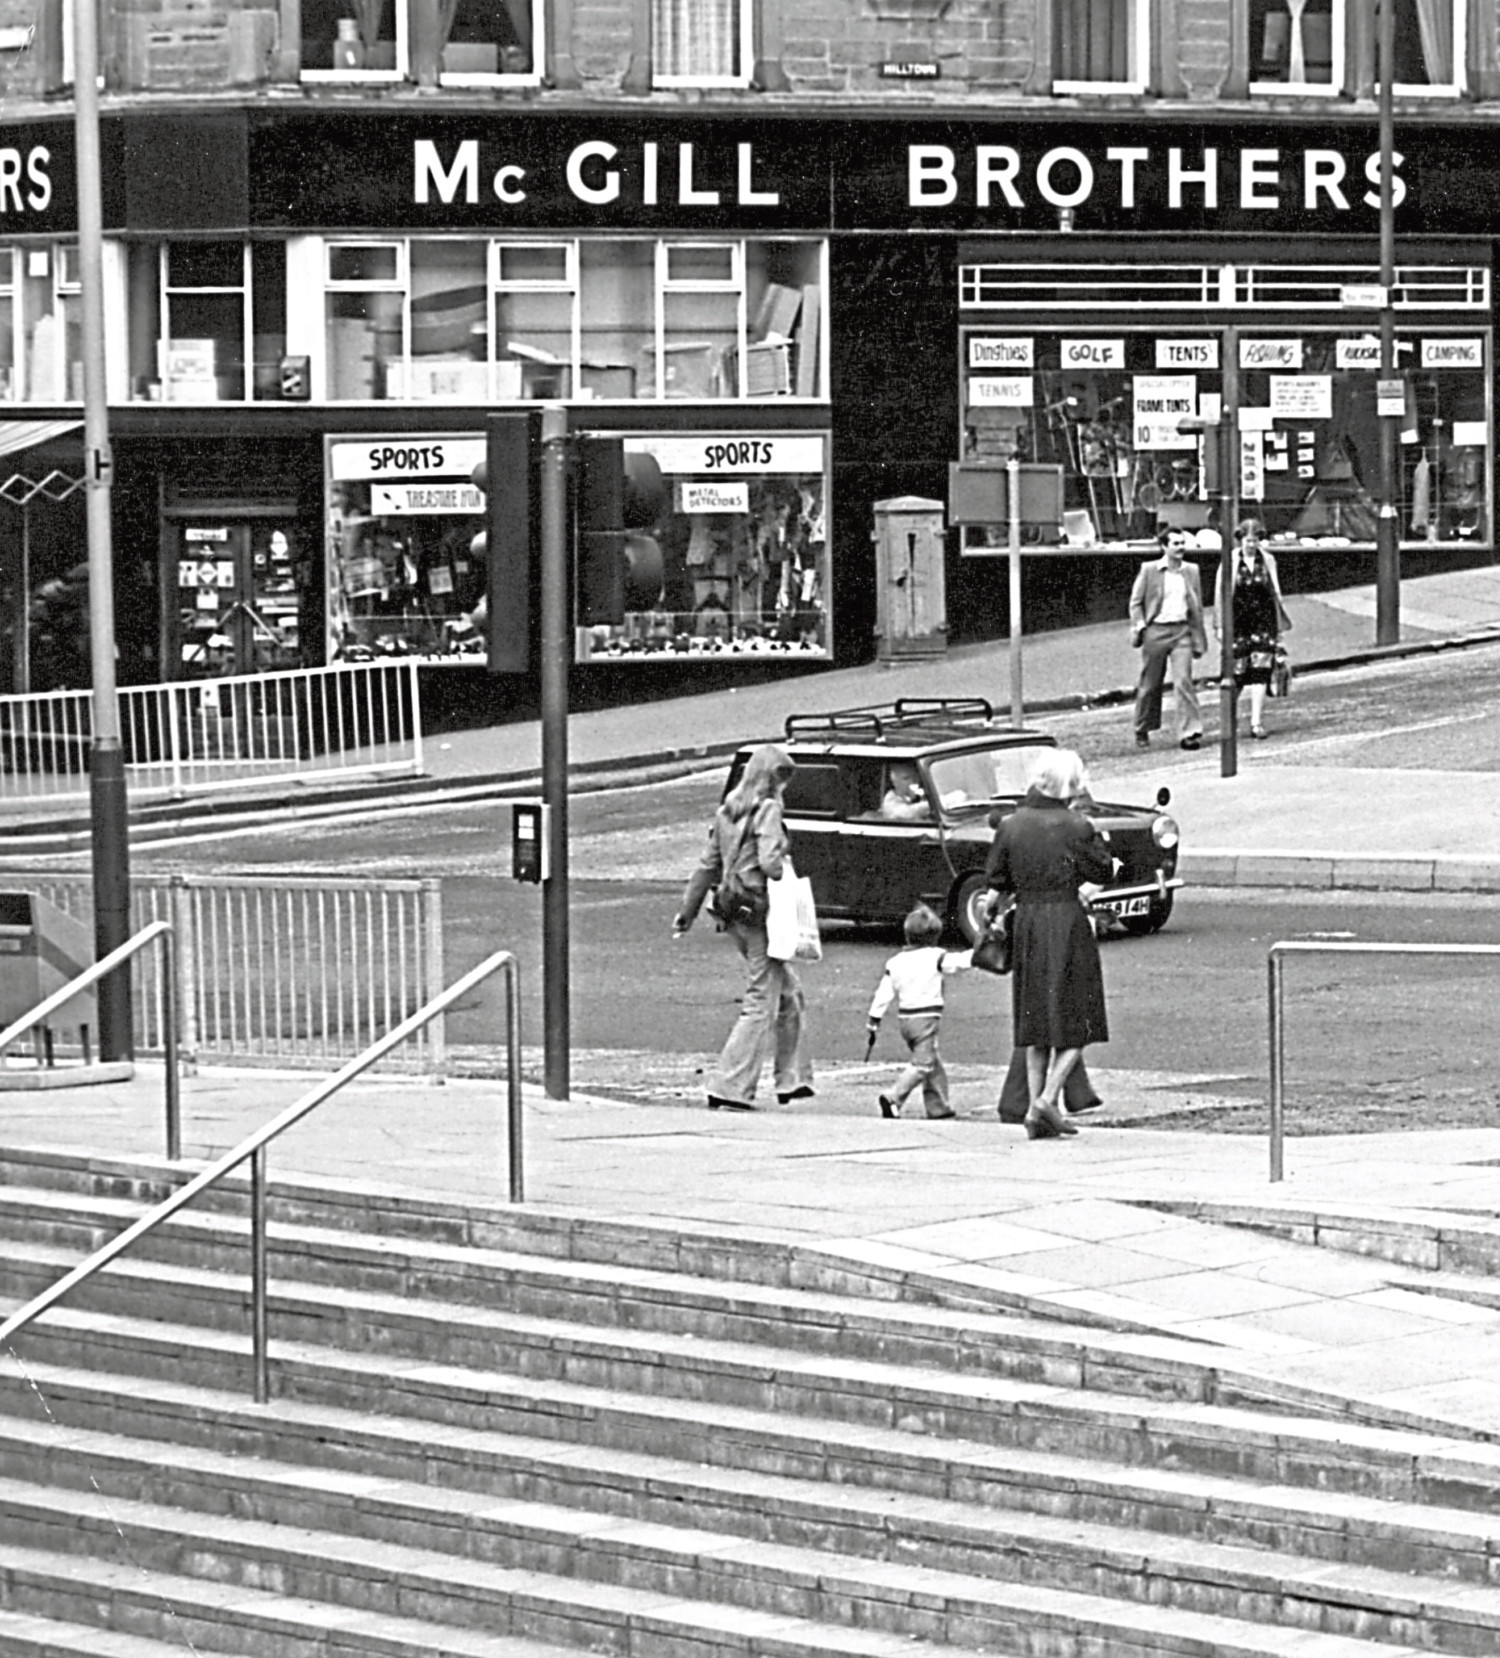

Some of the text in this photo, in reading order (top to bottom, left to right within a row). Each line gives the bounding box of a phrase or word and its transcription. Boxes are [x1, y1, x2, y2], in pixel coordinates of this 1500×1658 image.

[883, 63, 937, 75] HILLTOWN
[414, 139, 1407, 210] Mc GILL BROTHERS
[1068, 344, 1114, 363] GOLF
[1169, 346, 1208, 362] TENTS
[1245, 344, 1294, 364] FISHING
[1426, 345, 1476, 361] CAMPING
[978, 383, 1022, 398] TENNIS
[1137, 399, 1191, 413] FRAME TENTS
[369, 445, 444, 471] SPORTS
[704, 441, 774, 468] SPORTS
[405, 489, 481, 508] TREASURE HUN
[688, 487, 720, 498] METAL
[689, 495, 743, 508] DETECTORS
